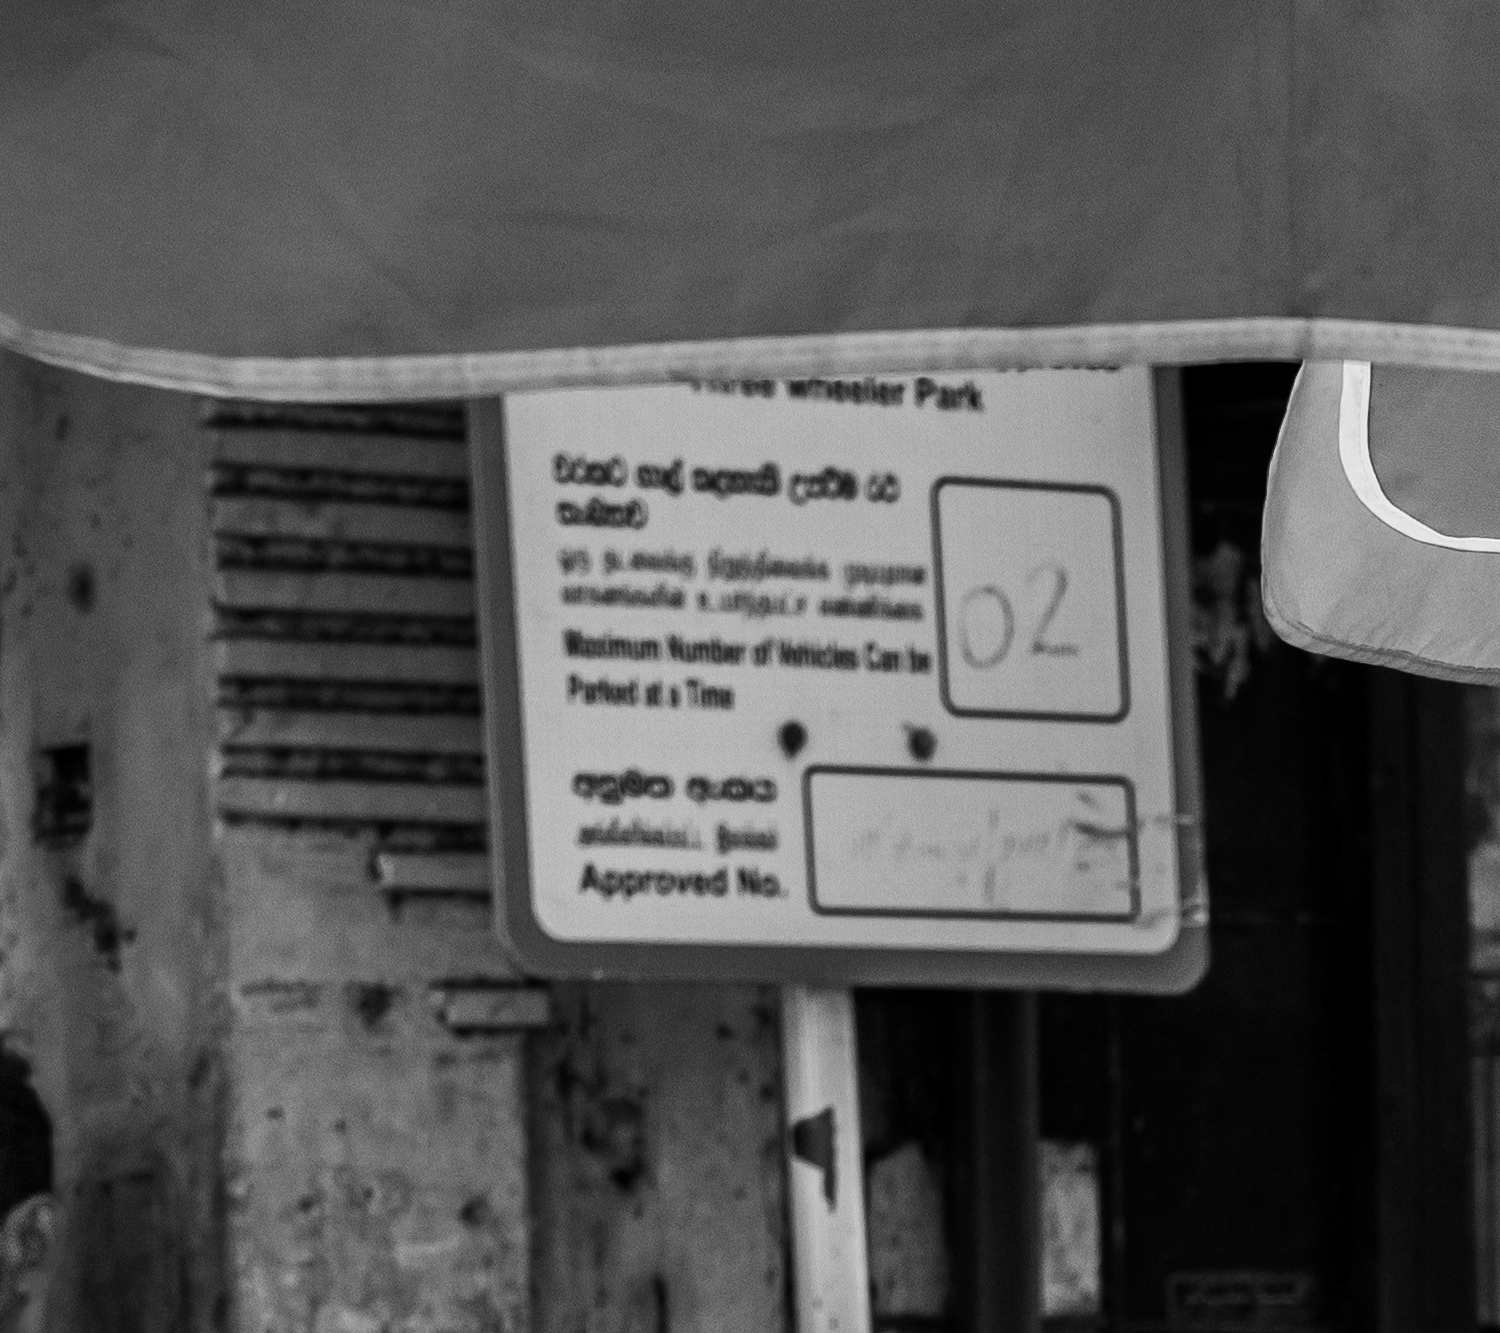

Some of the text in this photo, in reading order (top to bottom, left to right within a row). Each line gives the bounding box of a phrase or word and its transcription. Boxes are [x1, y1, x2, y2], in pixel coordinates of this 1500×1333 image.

[914, 376, 986, 414] Park
[957, 563, 1080, 670] 02
[563, 628, 931, 674] Maximum Number of Vehicles Can be
[567, 674, 735, 711] Parked at a Time
[580, 861, 789, 901] Approved No.
